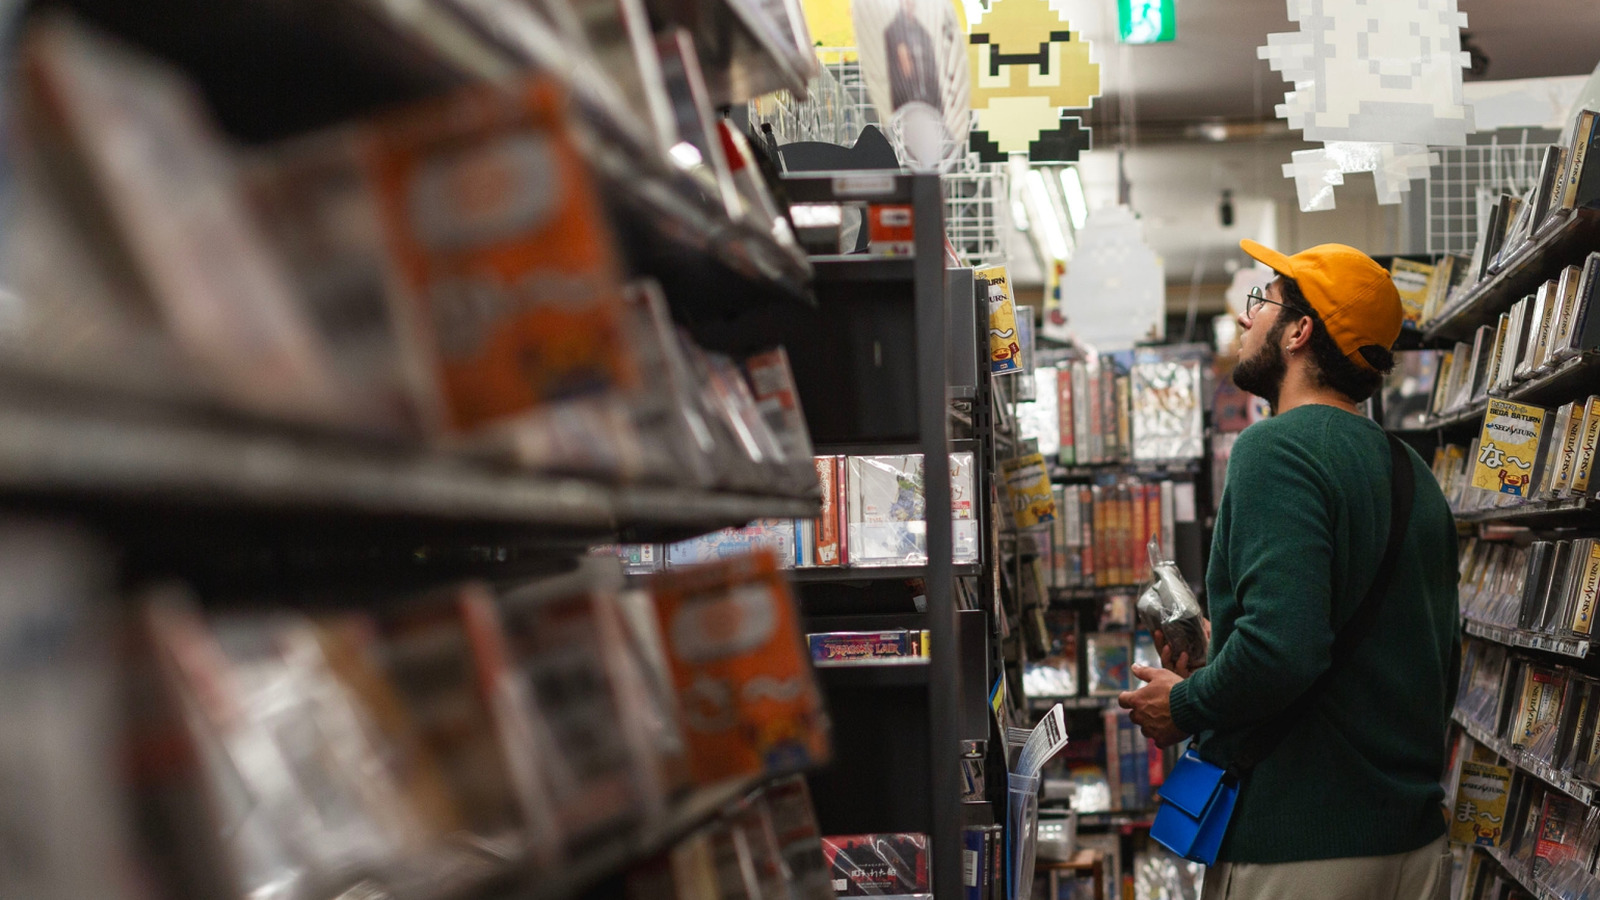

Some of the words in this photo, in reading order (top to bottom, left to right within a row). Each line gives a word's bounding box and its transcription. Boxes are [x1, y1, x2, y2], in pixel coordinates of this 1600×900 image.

[989, 294, 1009, 303] URN
[1490, 408, 1509, 417] SEGA
[1511, 412, 1541, 423] SATURN
